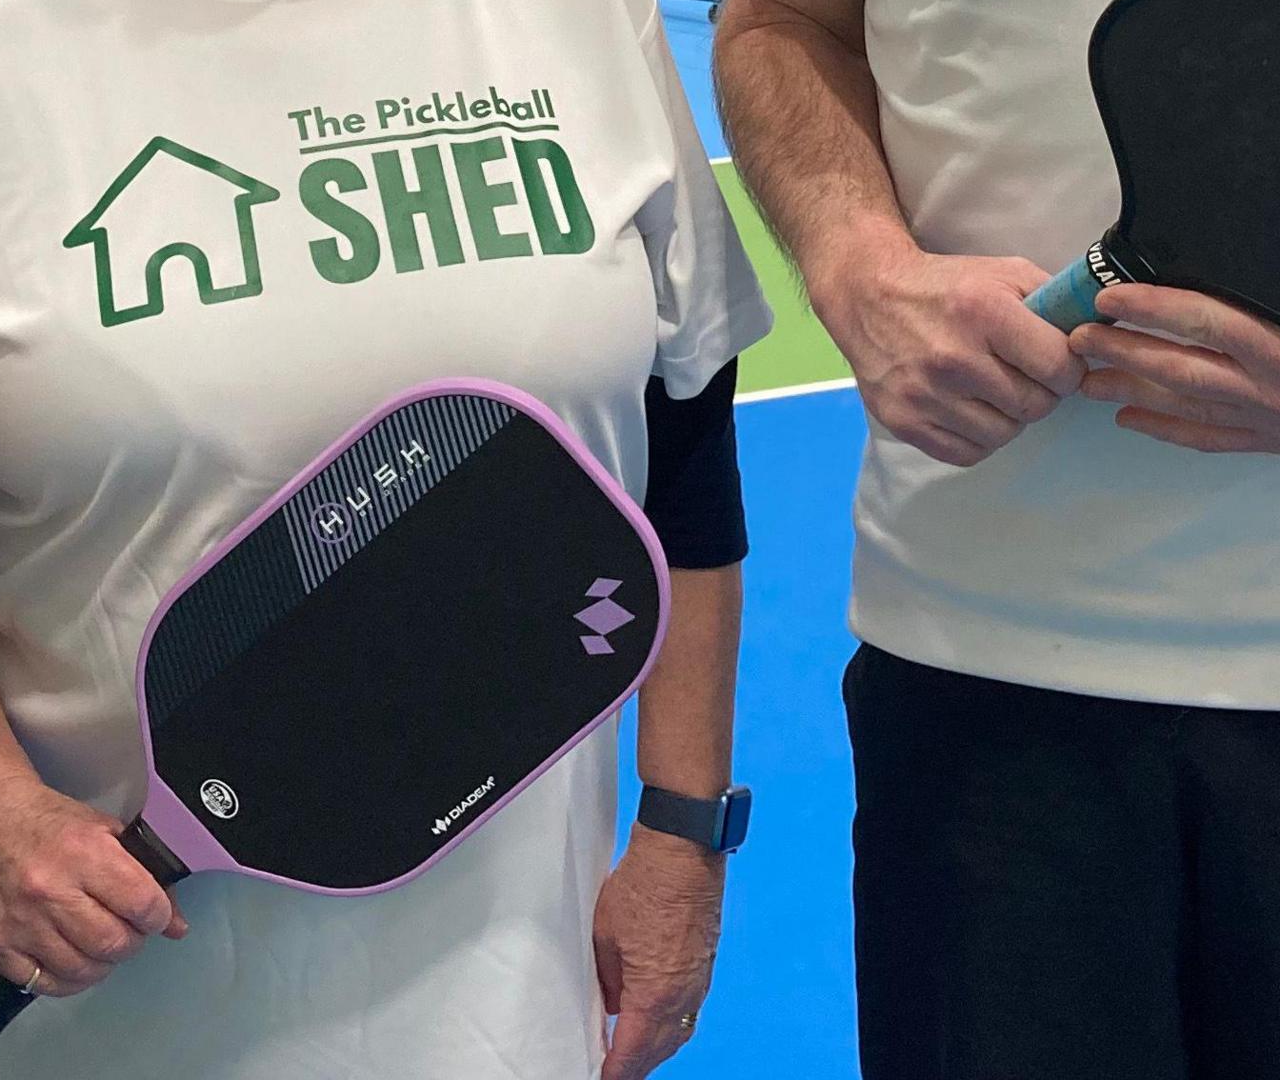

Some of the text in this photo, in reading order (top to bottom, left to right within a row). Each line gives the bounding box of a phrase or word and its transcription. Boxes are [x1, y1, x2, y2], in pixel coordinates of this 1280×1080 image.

[288, 86, 556, 141] The Pickleball
[298, 135, 596, 285] SHED
[319, 440, 425, 535] HUSH
[448, 779, 496, 821] DIADEM
